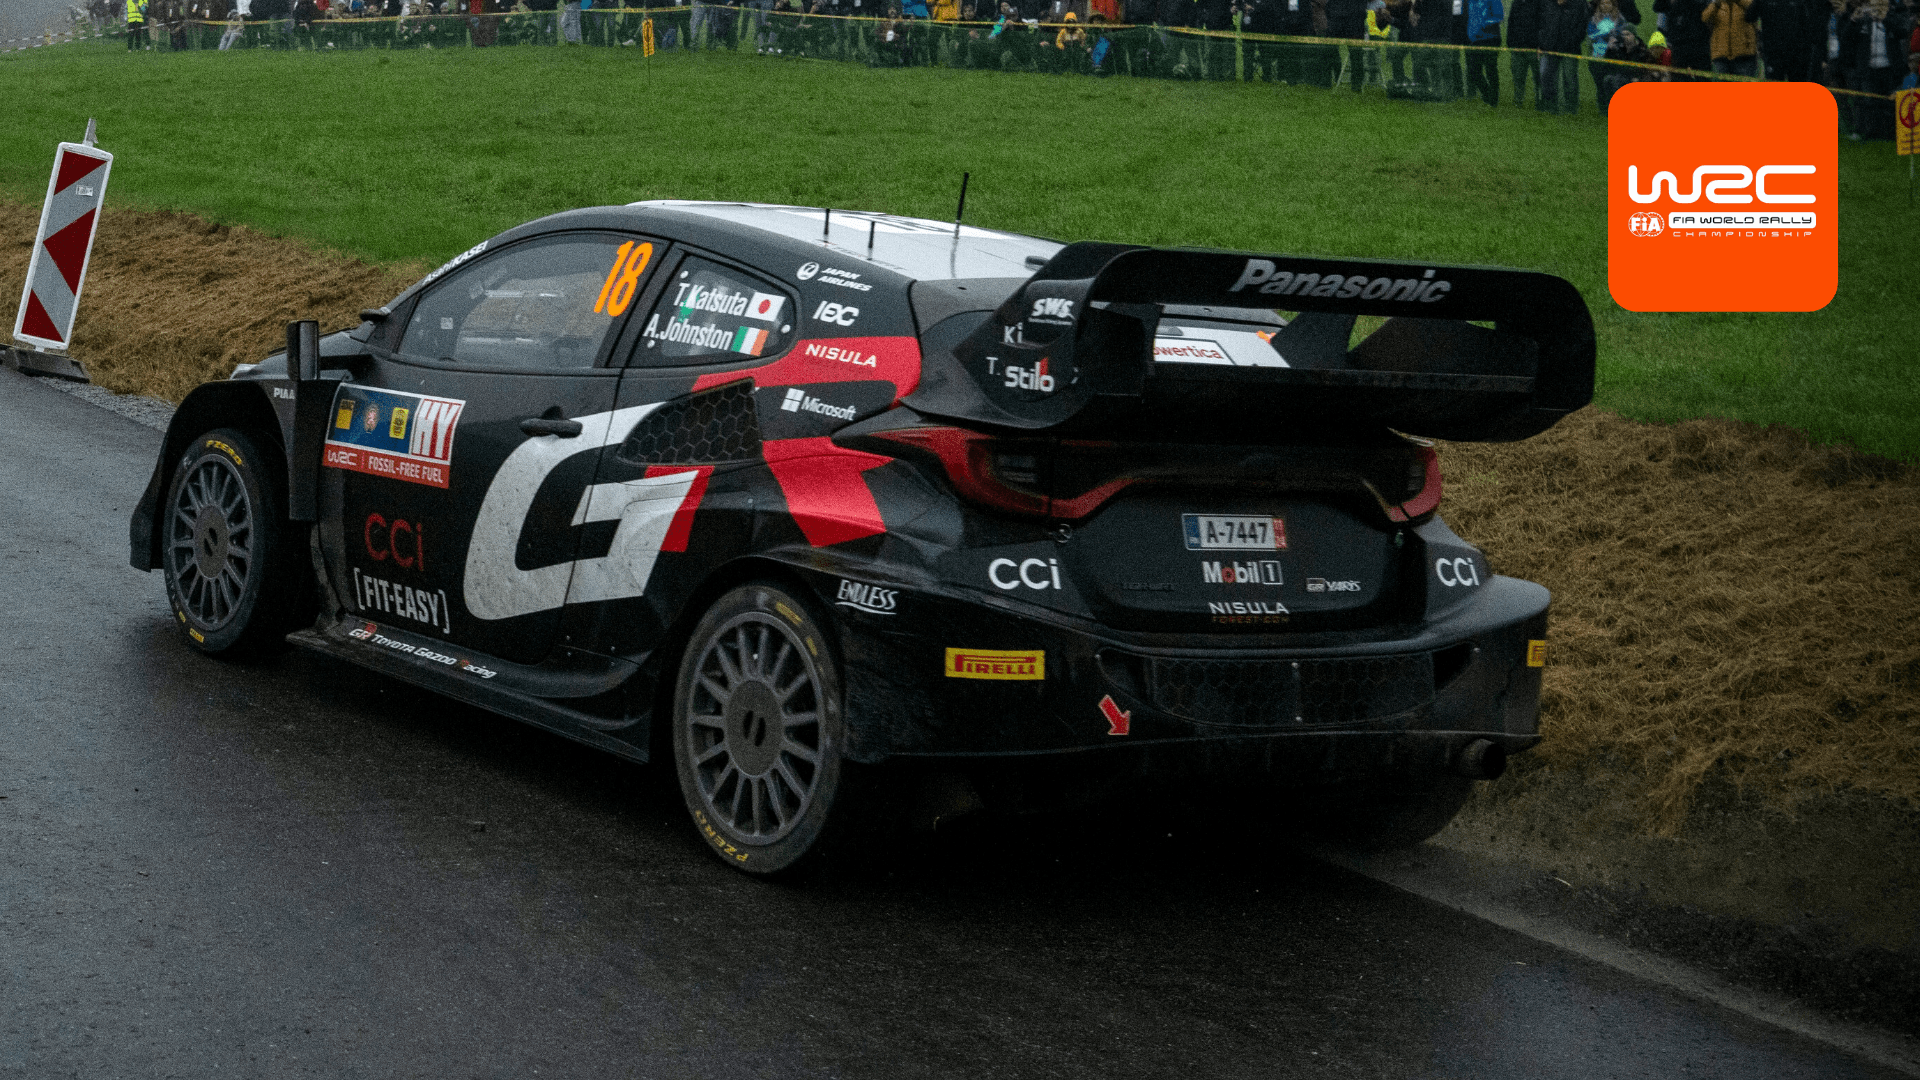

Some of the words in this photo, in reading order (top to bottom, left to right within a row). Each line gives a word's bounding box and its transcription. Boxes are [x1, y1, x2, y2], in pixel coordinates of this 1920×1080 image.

[593, 240, 653, 316] 18
[817, 275, 873, 291] AIRLINES
[821, 267, 861, 280] JAPAN
[1228, 258, 1452, 303] Panasonic
[642, 313, 734, 352] A.Johnston
[805, 343, 877, 368] NISULA
[1153, 345, 1224, 360] owertica
[1004, 358, 1055, 393] Stilo
[274, 387, 296, 400] PIAA
[801, 396, 857, 421] Microsoft
[411, 400, 462, 459] HY
[368, 455, 420, 479] FOSSIL-FREE
[421, 466, 443, 484] FUEL
[1206, 520, 1268, 544] A-7447
[1202, 560, 1260, 584] Mobil
[837, 579, 899, 610] ENDLESS
[1207, 601, 1290, 615] NISULA
[371, 633, 416, 653] TOYOTA
[413, 647, 458, 666] GAZOO
[954, 654, 1037, 675] PIRELLI
